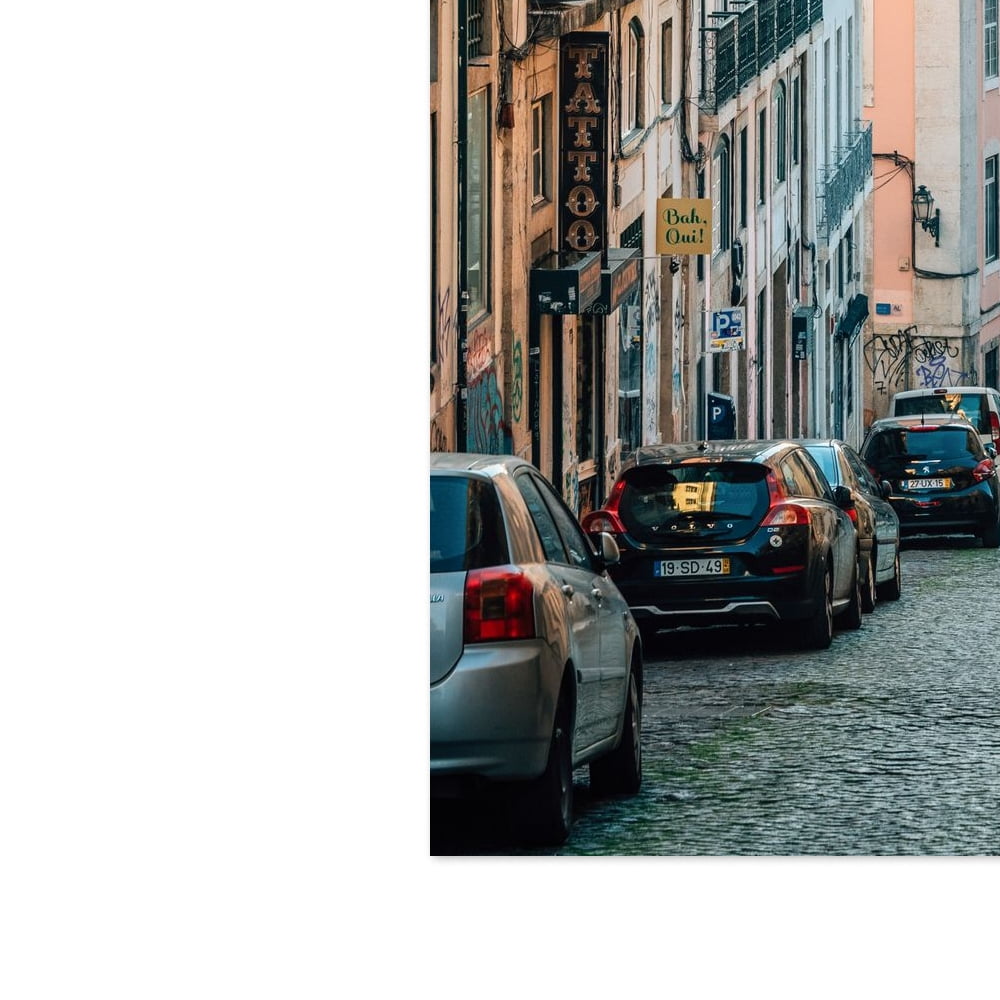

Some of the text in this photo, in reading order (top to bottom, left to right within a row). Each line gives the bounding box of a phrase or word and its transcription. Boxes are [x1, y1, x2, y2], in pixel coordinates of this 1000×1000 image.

[565, 47, 601, 250] TATTOO
[662, 207, 707, 225] Bah,
[665, 227, 705, 246] Oui!
[713, 406, 722, 420] P
[651, 523, 734, 531] VOLVO
